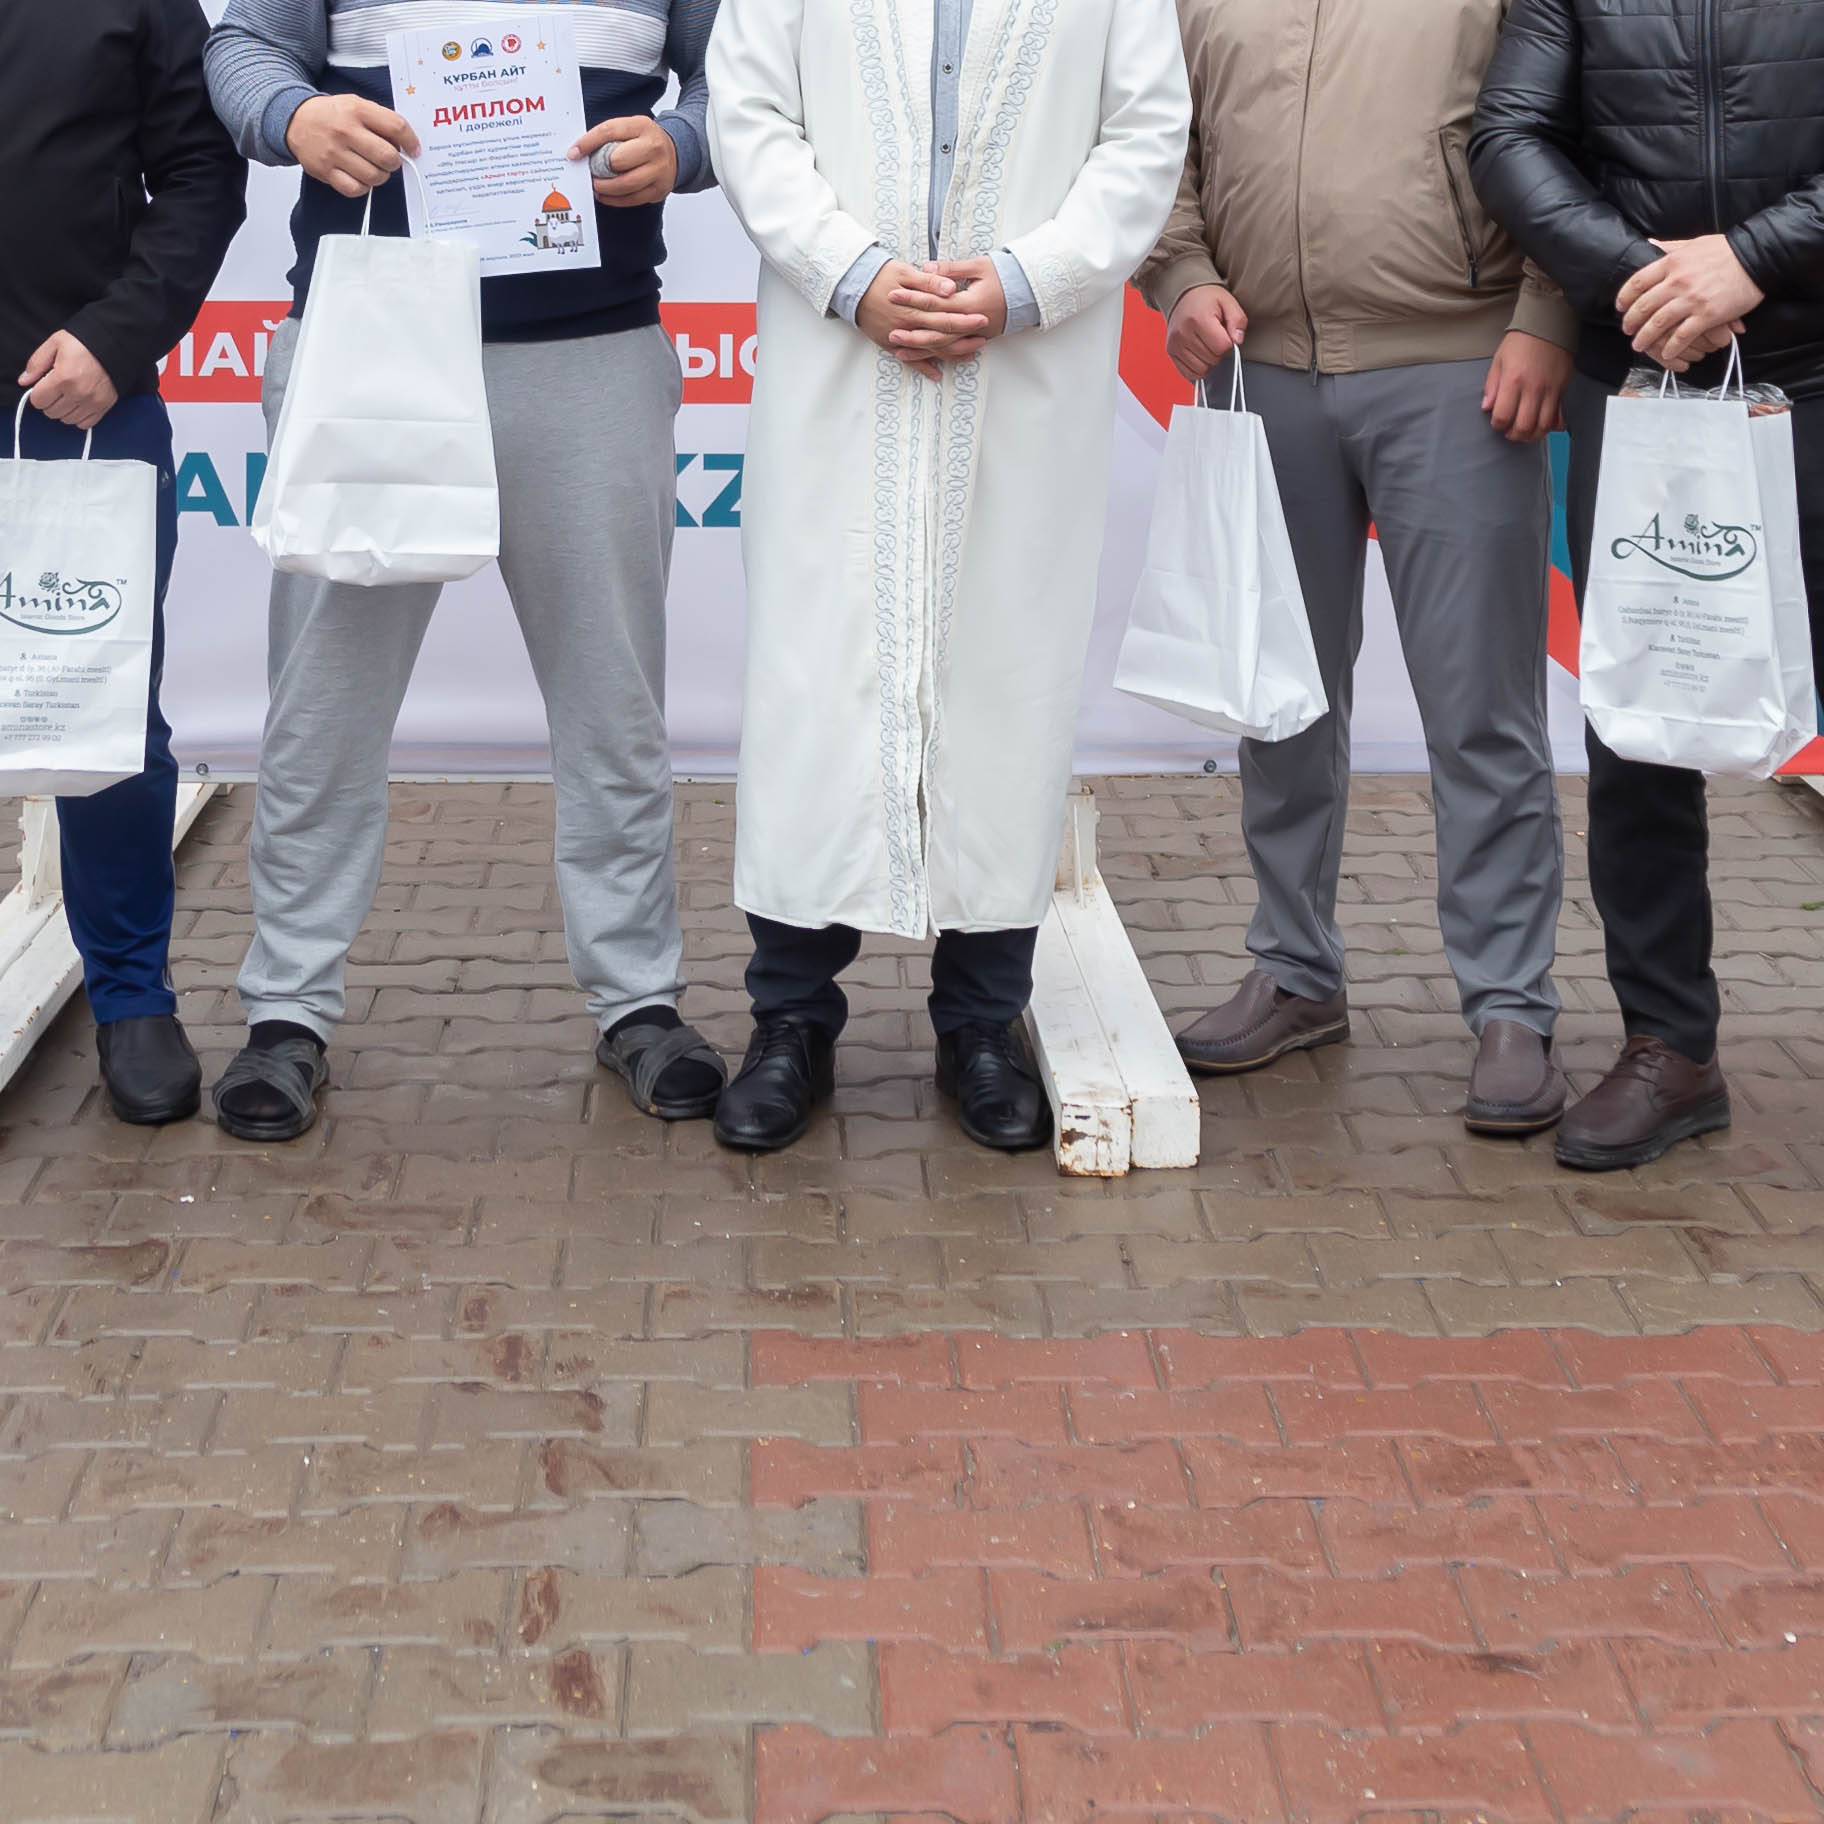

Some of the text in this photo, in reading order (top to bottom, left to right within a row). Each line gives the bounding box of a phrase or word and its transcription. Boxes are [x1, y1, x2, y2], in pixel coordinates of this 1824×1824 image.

[500, 64, 527, 78] АЙТ
[432, 95, 546, 127] ДИПЛОМ
[1613, 512, 1746, 562] Amina
